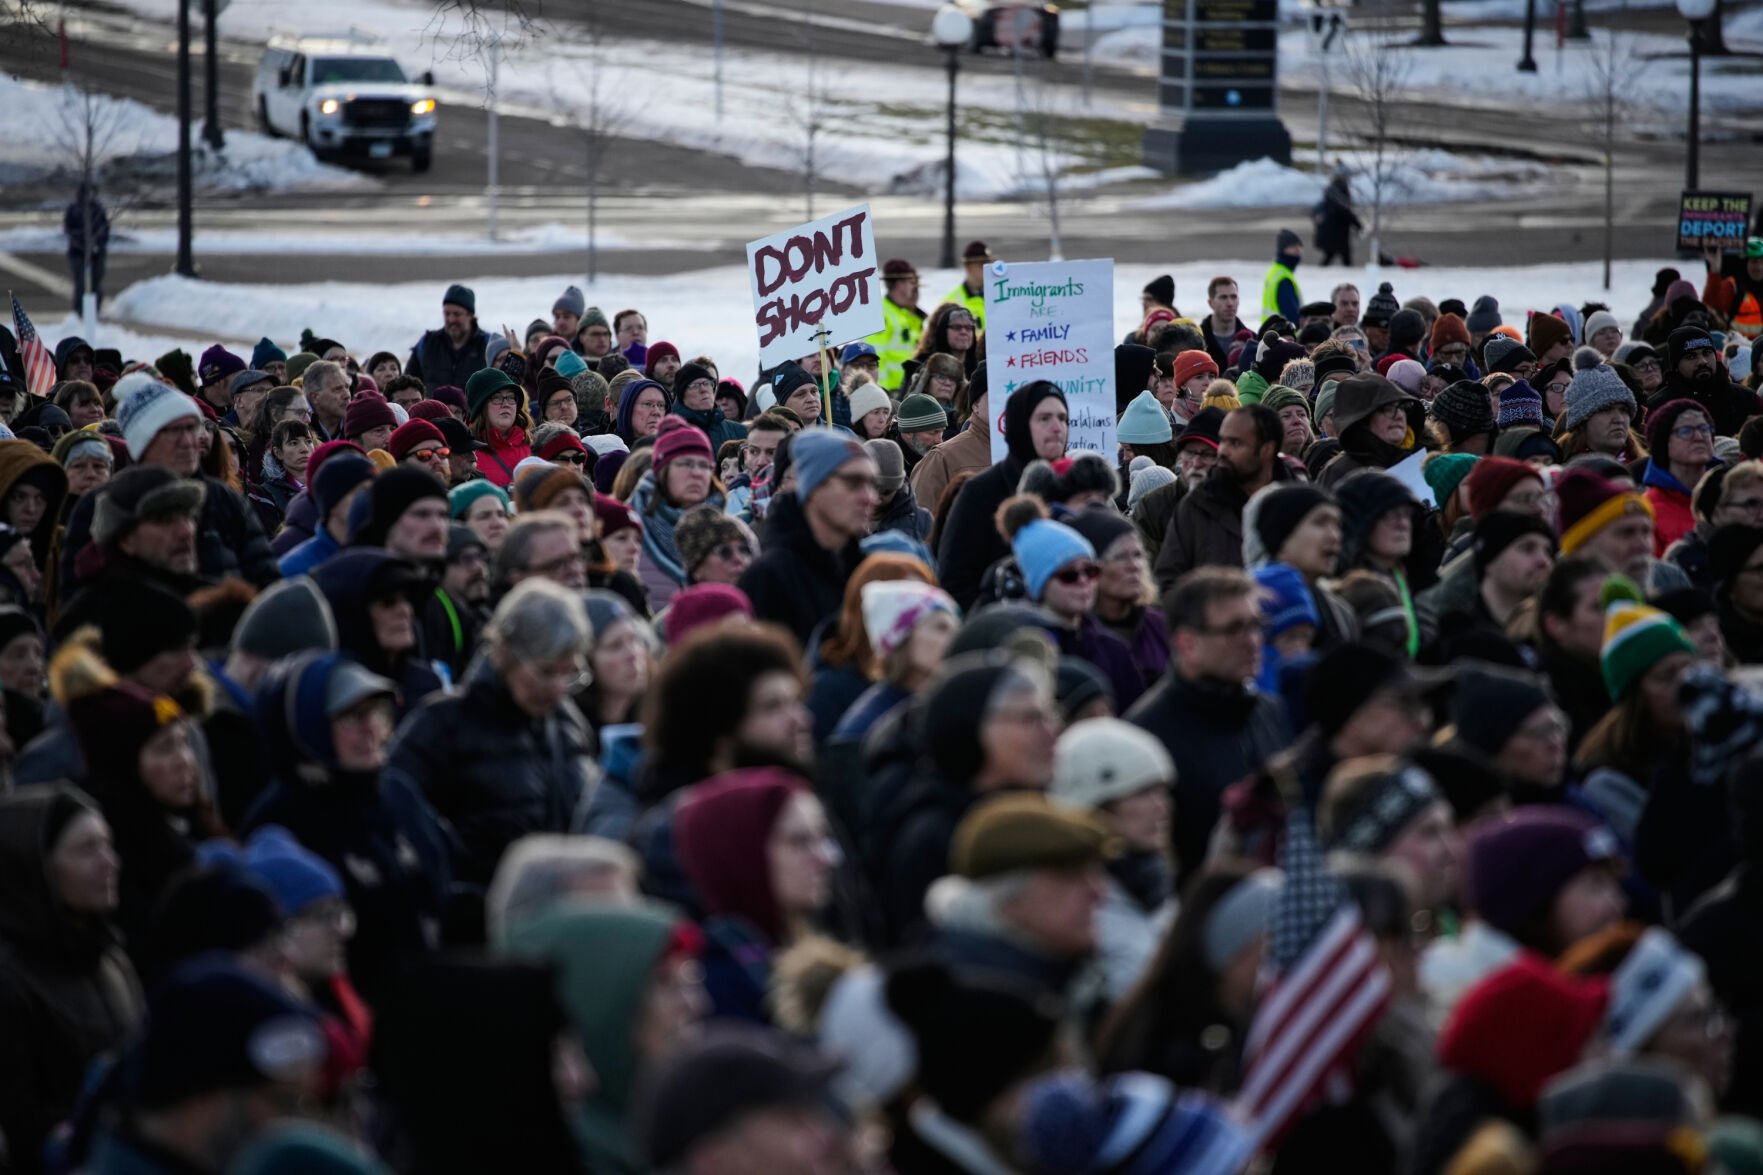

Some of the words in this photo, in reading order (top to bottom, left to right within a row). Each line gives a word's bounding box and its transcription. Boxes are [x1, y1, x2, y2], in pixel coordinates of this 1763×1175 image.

[1683, 197, 1719, 210] KEEP
[1722, 198, 1749, 213] THE
[1680, 220, 1745, 238] DEPORT
[755, 211, 866, 297] DONT
[993, 276, 1084, 307] Immigrants
[756, 267, 876, 348] SHOOT
